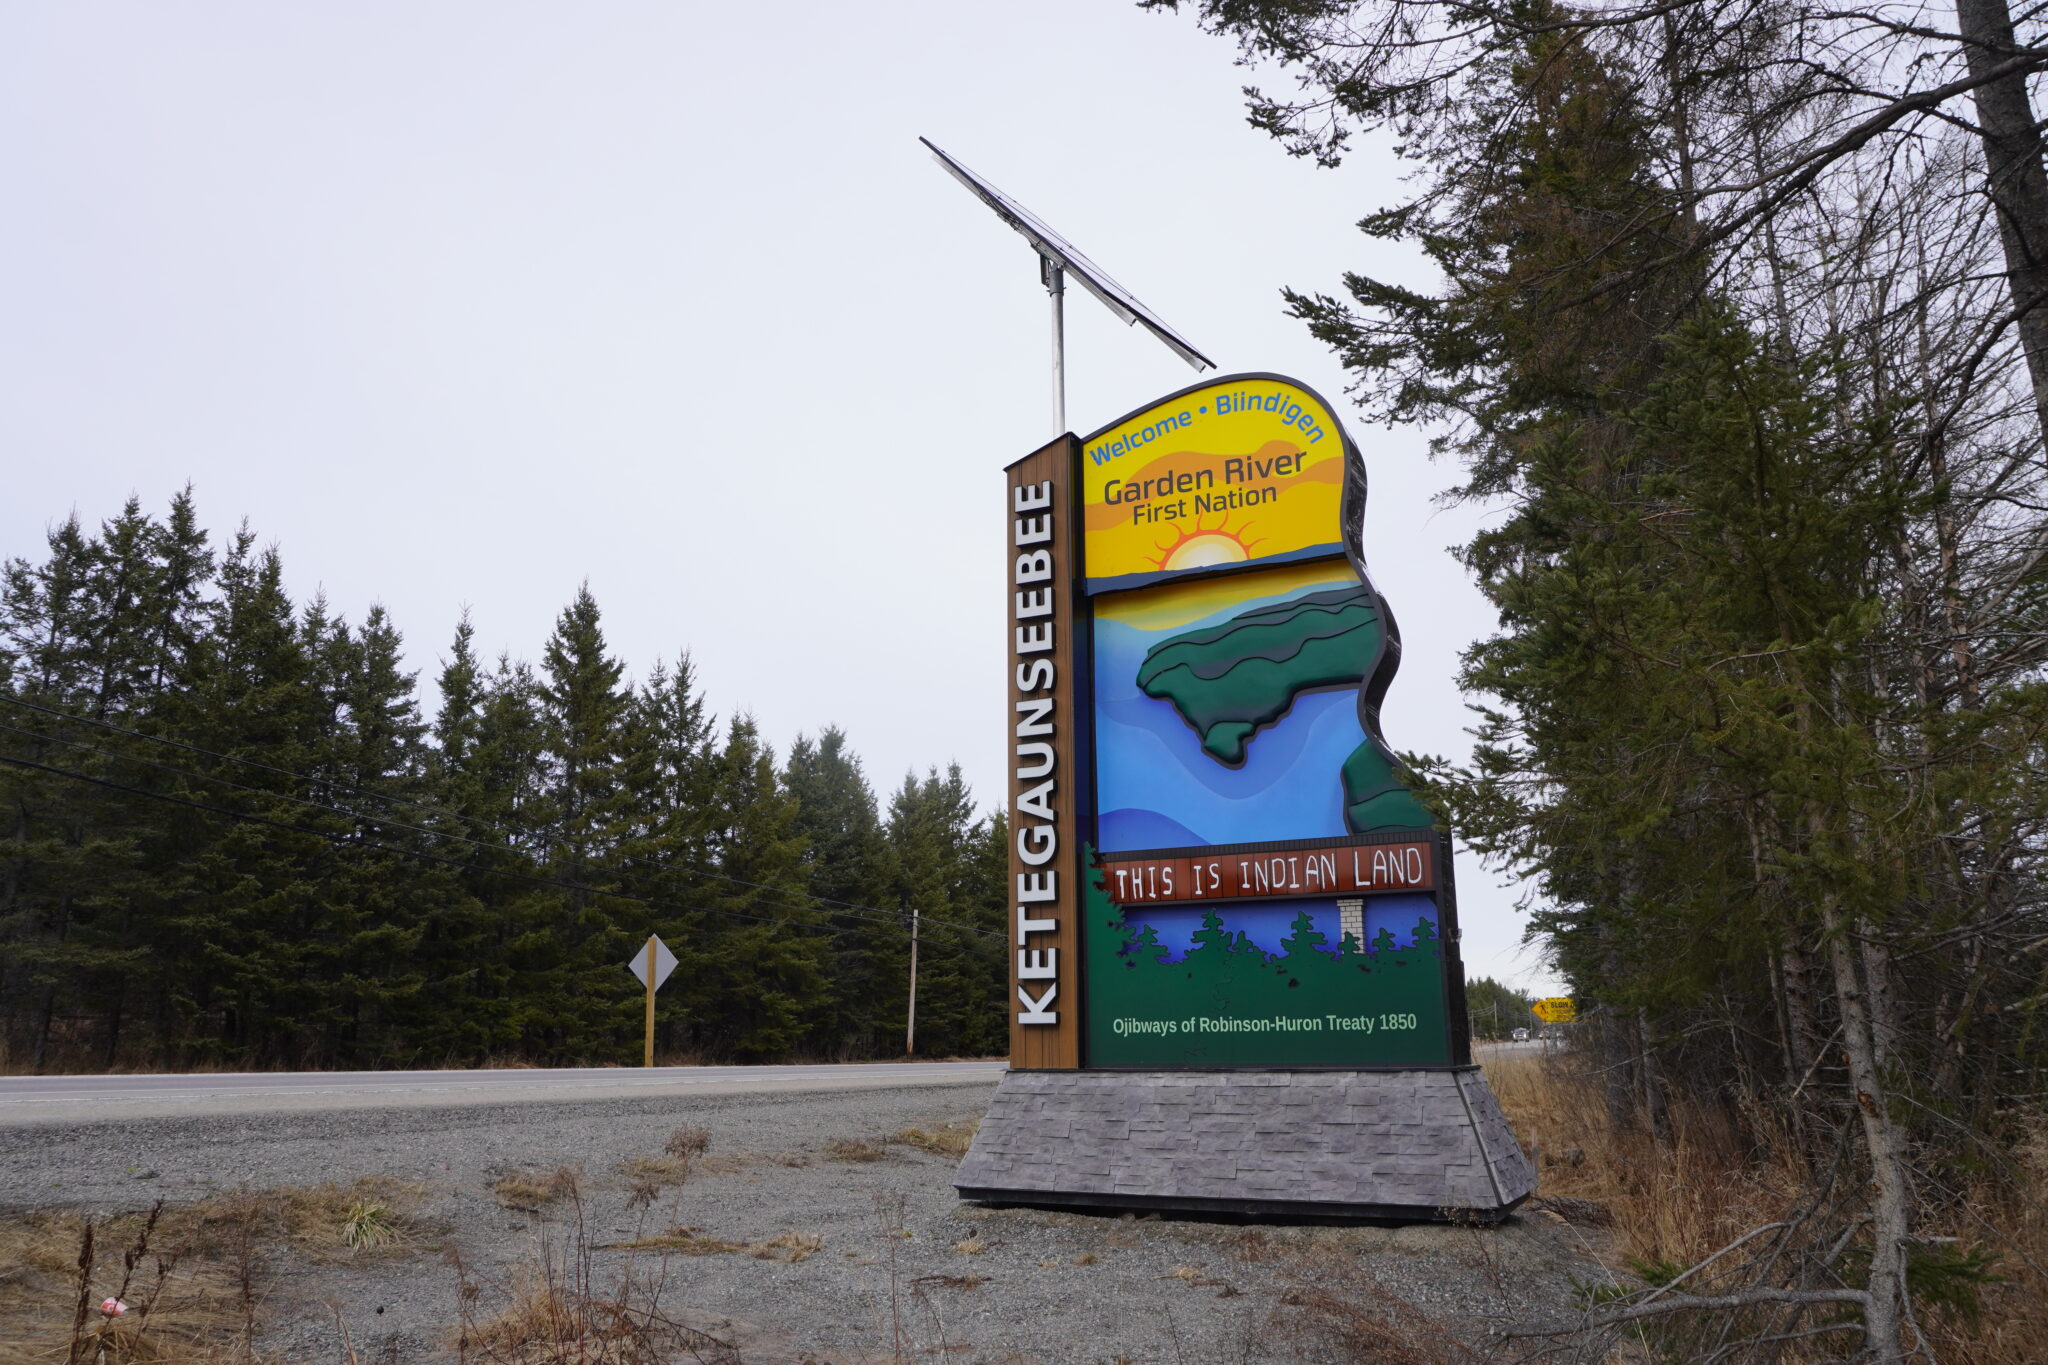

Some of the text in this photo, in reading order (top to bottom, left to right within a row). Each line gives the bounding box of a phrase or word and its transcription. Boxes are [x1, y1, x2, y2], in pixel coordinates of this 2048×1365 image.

[1089, 391, 1325, 466] Welcome Biindigen
[1104, 450, 1308, 506] Garden River
[1133, 485, 1277, 526] First Nation
[1015, 480, 1057, 1025] KETEGAUNSEEBEE
[1116, 847, 1423, 899] THIS IS INDIAN LAND
[1112, 1013, 1417, 1036] Ojibways of Robinson-Huron Treaty 1850
